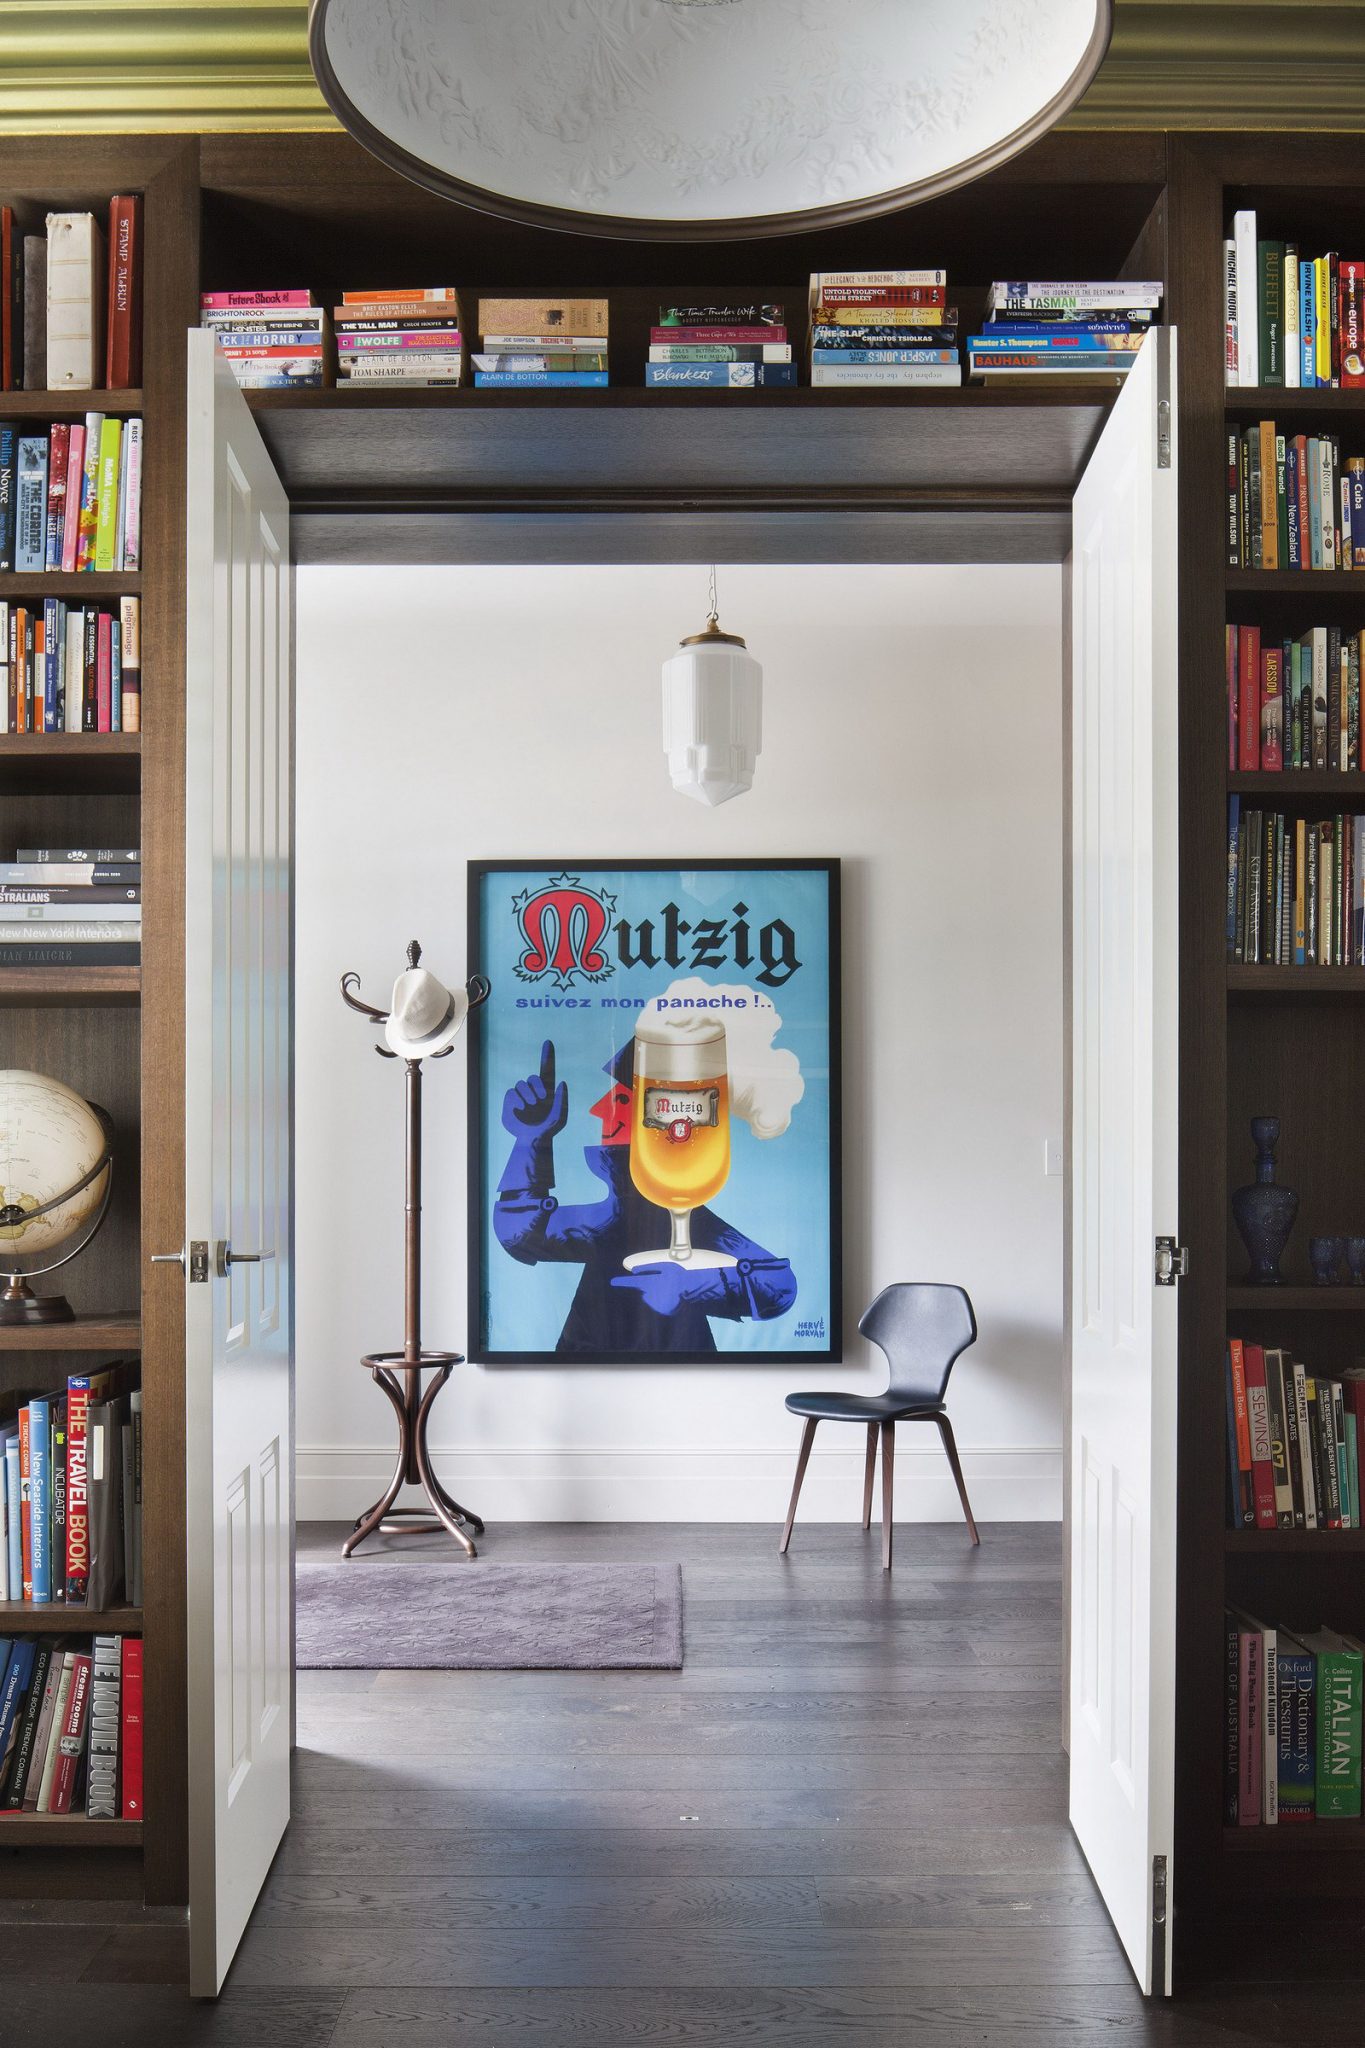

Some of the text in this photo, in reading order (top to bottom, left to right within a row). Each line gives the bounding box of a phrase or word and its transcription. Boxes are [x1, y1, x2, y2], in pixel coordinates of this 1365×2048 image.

[117, 219, 129, 311] STAMP ALBUM
[228, 292, 281, 305] Future Shock
[1227, 250, 1237, 321] MICHAEL MOORE
[1266, 252, 1278, 319] BUFFETT
[1288, 259, 1296, 332] BLACK GOLD
[667, 306, 757, 320] The Time Wife
[1005, 298, 1076, 309] THE TASMAN
[253, 334, 302, 345] HORNBY
[362, 337, 399, 346] WOLFE
[1008, 339, 1048, 347] Thompson
[1347, 309, 1358, 348] europe
[373, 368, 406, 376] SHARPE
[652, 367, 713, 381] Blankets
[868, 352, 937, 362] JASPER JONES
[975, 357, 1037, 366] BAUHAUS
[0, 430, 12, 503] Phillip Noyce
[1265, 432, 1274, 476] International
[1277, 439, 1285, 459] Bradt
[101, 458, 113, 527] MoMA Highlights
[1323, 469, 1332, 497] ROME
[1354, 483, 1363, 509] Cuba
[30, 480, 42, 553] THE CORNER
[1229, 494, 1237, 545] TONY WILSON
[1267, 497, 1275, 519] Guide
[1300, 484, 1309, 535] PROVENCE
[1288, 505, 1298, 562] New Zealand
[125, 605, 136, 655] pilgrimage
[1266, 653, 1277, 693] LARSSON
[1229, 840, 1237, 875] Australian
[1228, 877, 1236, 897] Open
[1250, 856, 1260, 933] KOFI ANNAN
[23, 928, 47, 938] New
[50, 928, 73, 938] York
[77, 928, 122, 938] Interiors
[512, 876, 803, 990] Mutzig
[28, 951, 72, 961] LIAIGRE
[516, 995, 592, 1008] suivez
[602, 998, 646, 1008] mon
[657, 995, 747, 1012] panache
[657, 1098, 703, 1115] Mutzig
[794, 1330, 825, 1338] MORVAN
[798, 1316, 824, 1329] HERVÉ
[1234, 1365, 1242, 1393] Layout
[1237, 1396, 1245, 1418] Book
[1252, 1394, 1269, 1452] SEWING
[1286, 1381, 1297, 1440] ULTIMATE PILATES
[1324, 1404, 1333, 1444] DESIGNER'S
[1271, 1440, 1284, 1469] 07
[1327, 1445, 1335, 1476] DESKTOP
[55, 1467, 65, 1524] INCUBATOR
[69, 1393, 88, 1572] THE TRAVEL BOOK
[1330, 1478, 1339, 1508] MANUAL
[33, 1452, 44, 1568] New Seaside Interiors
[1248, 1660, 1256, 1676] Big
[1278, 1662, 1312, 1672] Oxford
[6, 1676, 17, 1700] Dream
[71, 1666, 88, 1734] dream rooms
[1229, 1633, 1237, 1774] BEST OF AUSTRALIA
[1268, 1647, 1276, 1736] Threatened Kingdom
[0, 1701, 12, 1726] Houses
[13, 1652, 47, 1790] ECO HOUSE BOOK TERENCE CONRAN
[56, 1704, 65, 1726] home
[89, 1635, 120, 1817] THE MOVIE BOOK
[1281, 1676, 1296, 1760] Thesaurus
[1293, 1678, 1313, 1773] Dictionary &
[1331, 1677, 1352, 1774] ITALIAN
[1323, 1720, 1331, 1774] DICTIONARY
